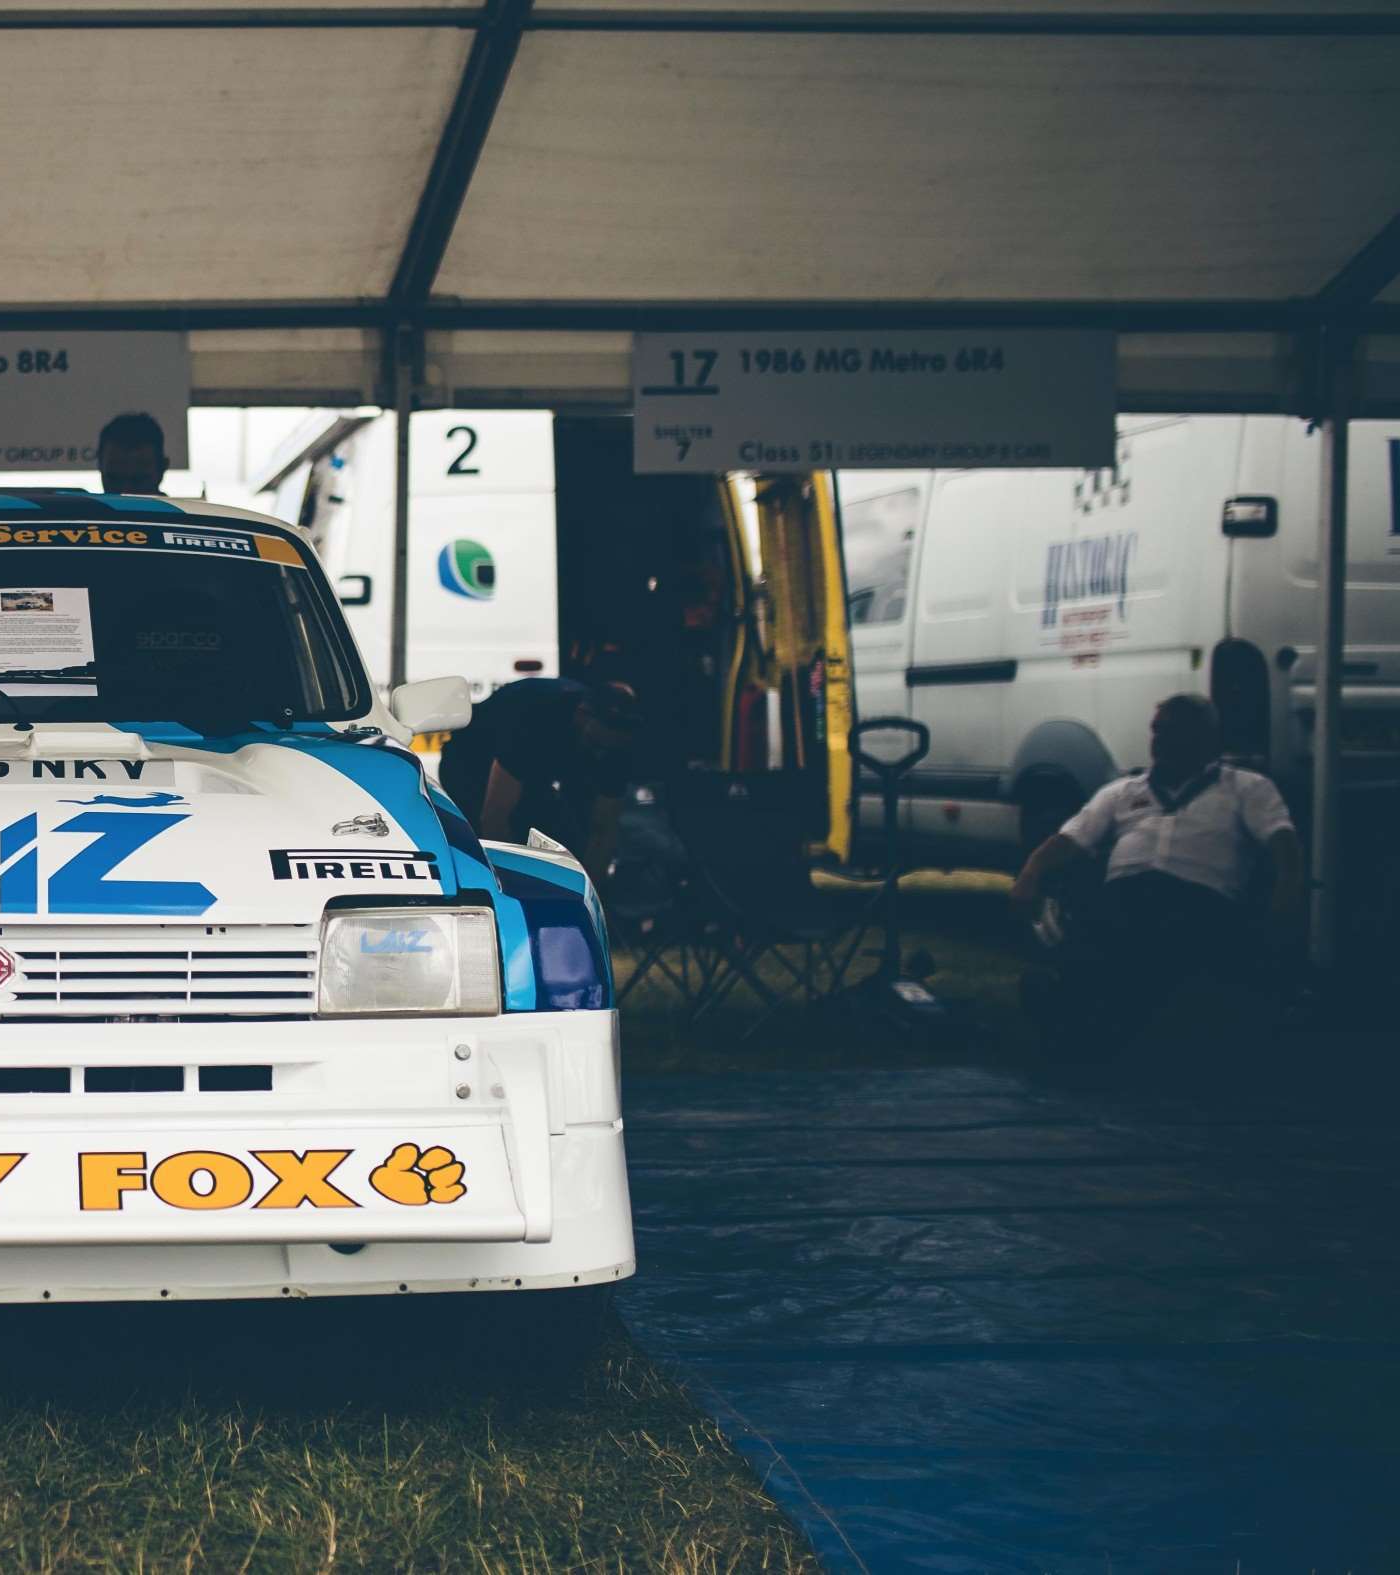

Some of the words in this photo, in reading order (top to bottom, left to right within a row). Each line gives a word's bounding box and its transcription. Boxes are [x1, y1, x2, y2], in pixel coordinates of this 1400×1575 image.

[16, 349, 70, 374] 8R4
[669, 350, 719, 386] 17
[739, 348, 807, 374] 1986
[813, 347, 861, 373] MG
[870, 348, 947, 373] Metro
[954, 347, 1006, 373] 6R4
[6, 446, 64, 463] GROUP
[446, 426, 480, 475] 2
[676, 438, 693, 463] 7
[738, 440, 800, 463] Class
[162, 531, 251, 552] PIRELLI
[135, 630, 223, 648] sparco
[268, 849, 442, 881] PIRELLI
[77, 1149, 364, 1211] FOX
